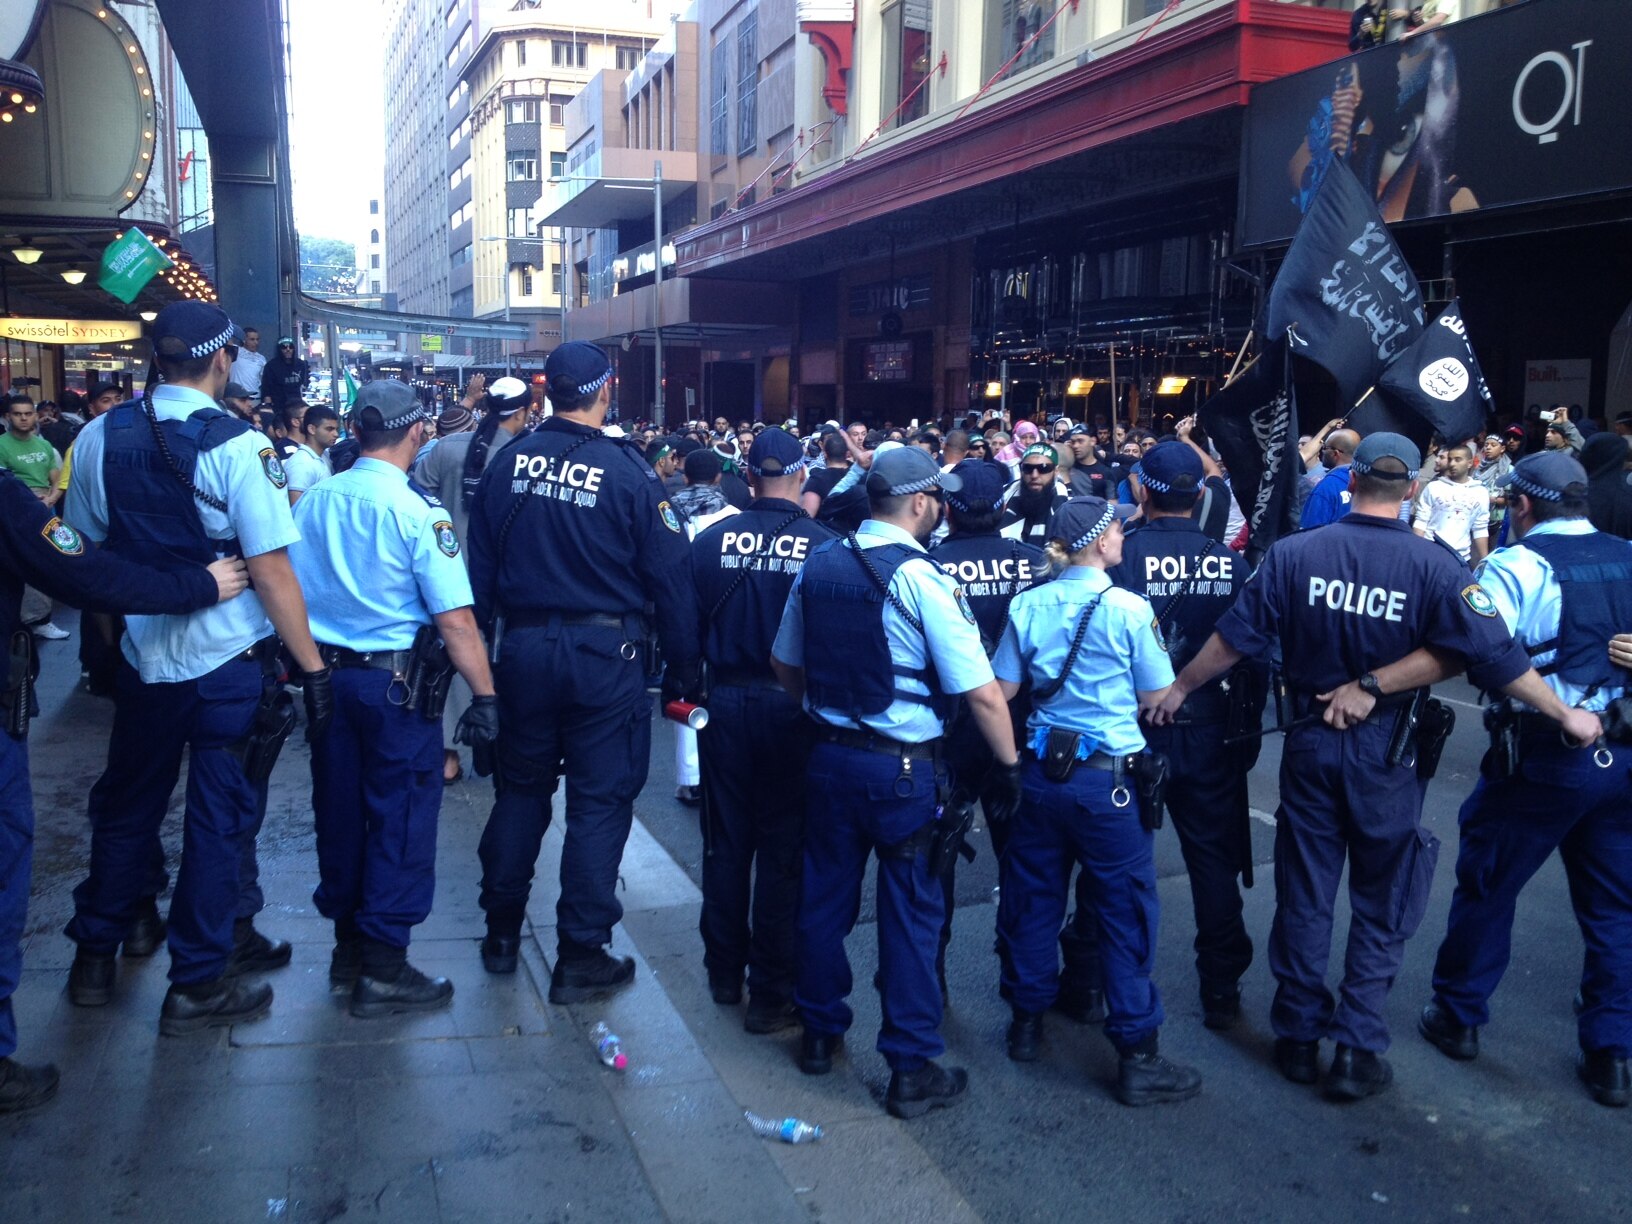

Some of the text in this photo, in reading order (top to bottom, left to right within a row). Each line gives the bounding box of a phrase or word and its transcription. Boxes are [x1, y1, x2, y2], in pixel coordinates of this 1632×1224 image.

[1512, 39, 1594, 145] QT
[7, 322, 128, 338] swissôtel SYDNEY
[513, 454, 604, 492] POLICE
[574, 490, 597, 508] SQUAD
[721, 532, 809, 559] POLICE
[942, 559, 1033, 582] POLICE
[1145, 555, 1233, 580] POLICE
[969, 582, 990, 596] ORDER
[991, 581, 998, 595] &
[1146, 582, 1168, 597] PUBLIC
[1196, 581, 1212, 595] RIOT
[1212, 581, 1232, 597] SQUAD
[1308, 576, 1408, 622] POLICE
